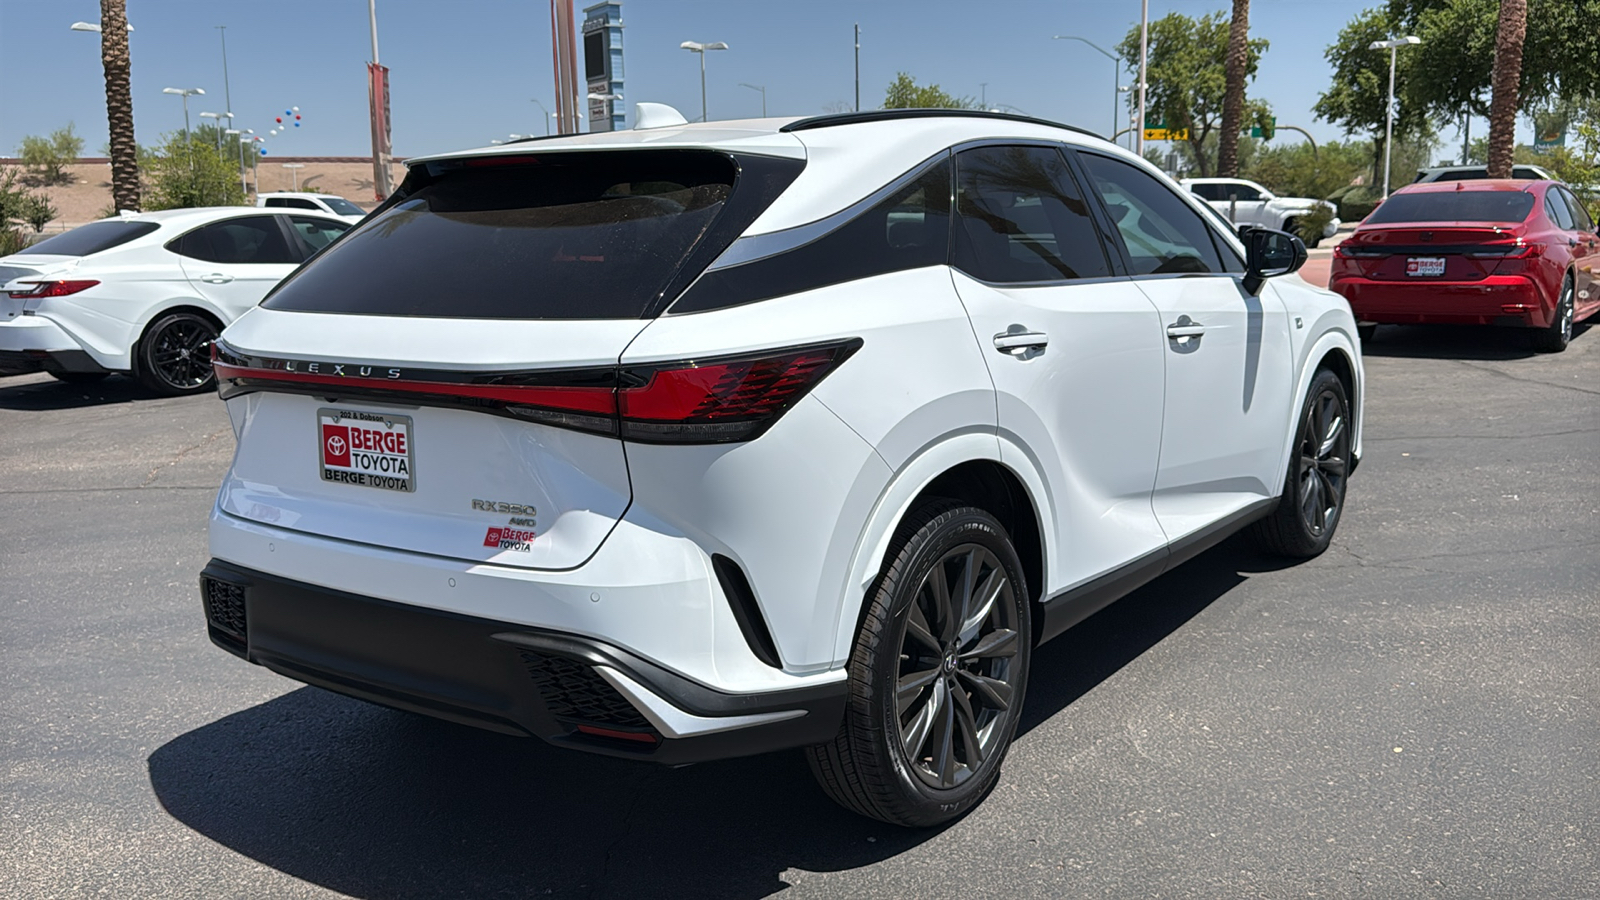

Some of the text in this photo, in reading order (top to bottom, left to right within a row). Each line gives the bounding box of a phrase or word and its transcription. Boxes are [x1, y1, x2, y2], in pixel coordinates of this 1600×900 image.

[286, 361, 401, 379] LEXUS
[340, 411, 352, 419] 202
[360, 413, 384, 422] Dobson
[350, 426, 406, 454] BERGE
[352, 453, 409, 474] TOYOTA
[325, 469, 408, 491] BERGE TOYOTA
[471, 499, 537, 517] RX350
[508, 517, 536, 527] AWD
[502, 528, 535, 542] BERGE
[500, 540, 531, 552] TOYOTA
